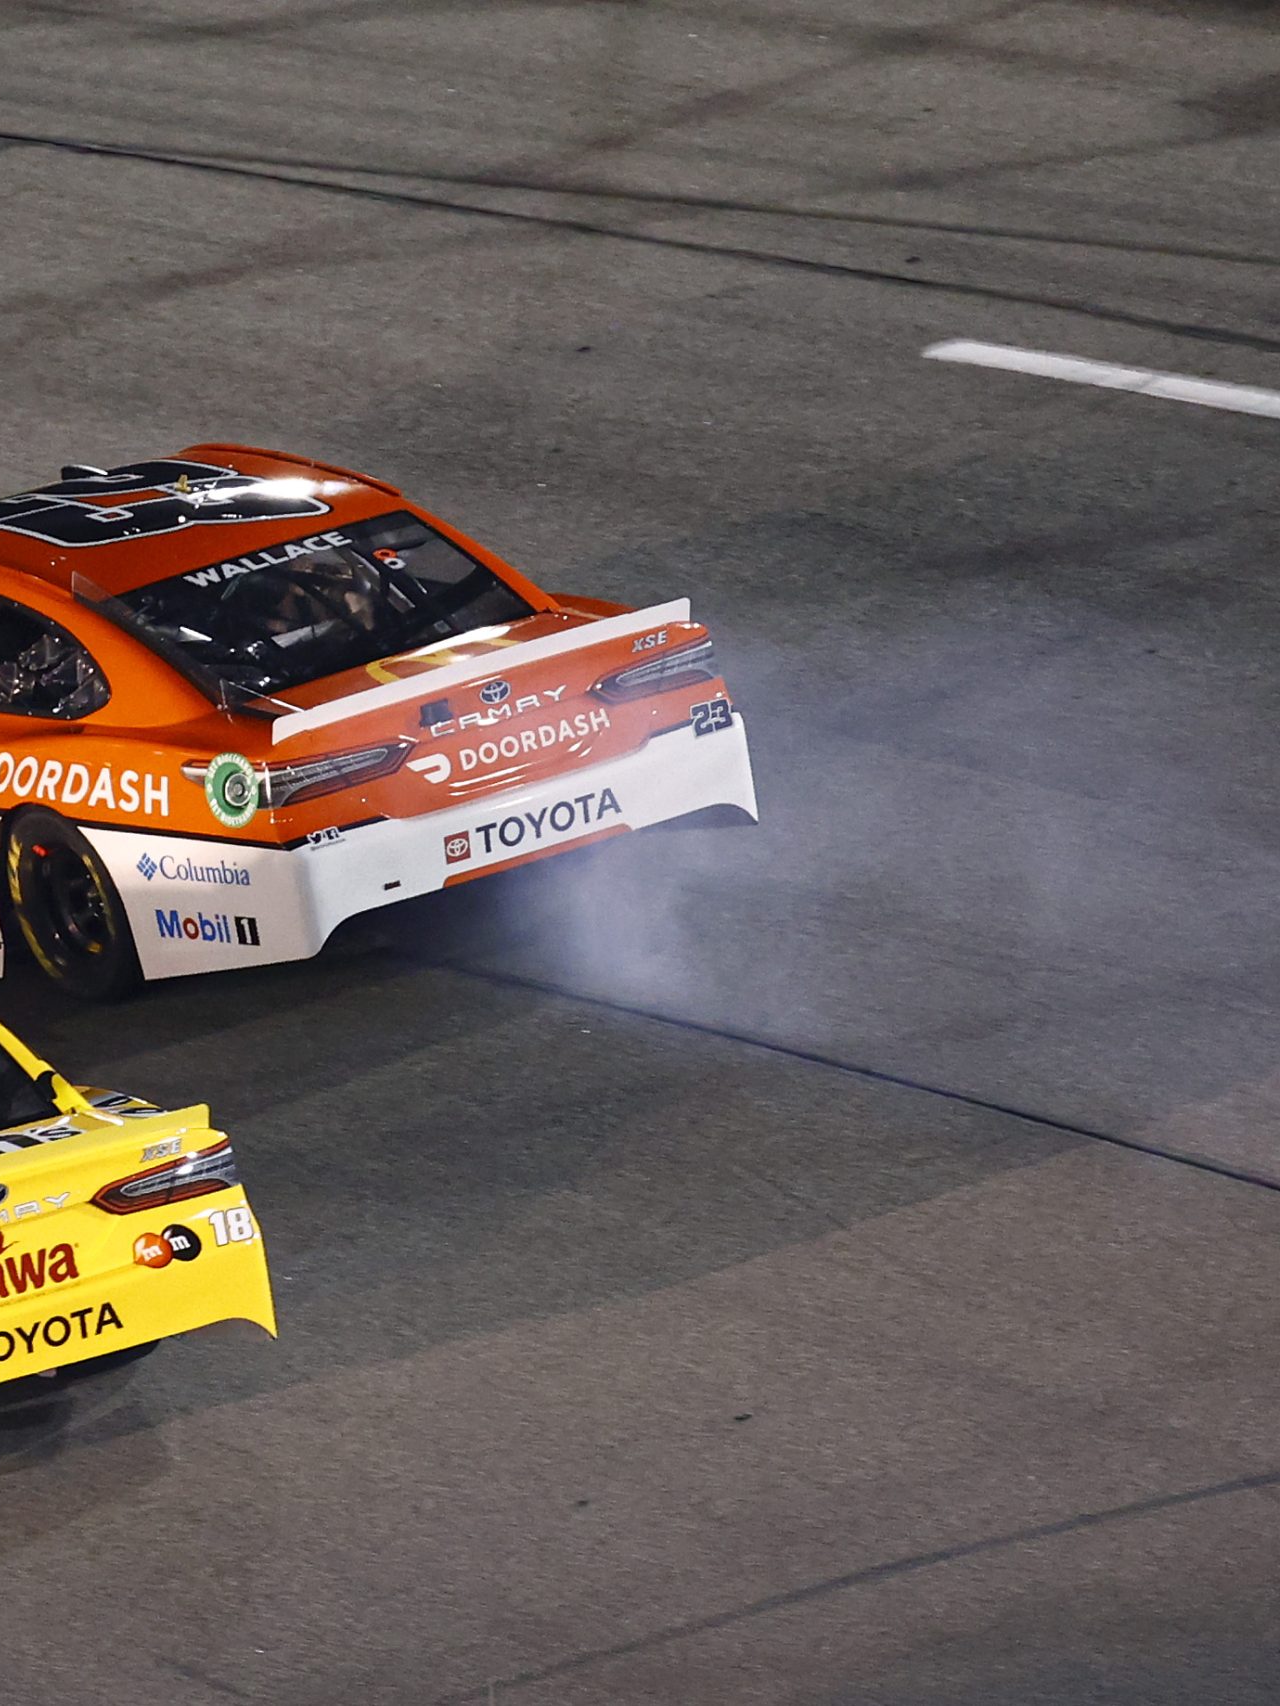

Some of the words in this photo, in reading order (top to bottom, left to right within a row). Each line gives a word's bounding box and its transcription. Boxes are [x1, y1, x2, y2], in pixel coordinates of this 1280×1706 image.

[184, 529, 354, 588] WALLACE
[632, 630, 668, 653] XSE
[430, 685, 567, 737] CAMRY
[690, 700, 735, 738] 23
[460, 708, 612, 772] DOORDASH
[475, 787, 622, 853] TOYOTA
[159, 854, 251, 886] Columbia
[155, 908, 230, 944] Mobil
[237, 917, 259, 945] 1
[140, 1138, 182, 1162] XSE
[168, 1235, 191, 1251] m
[209, 1206, 254, 1247] 18
